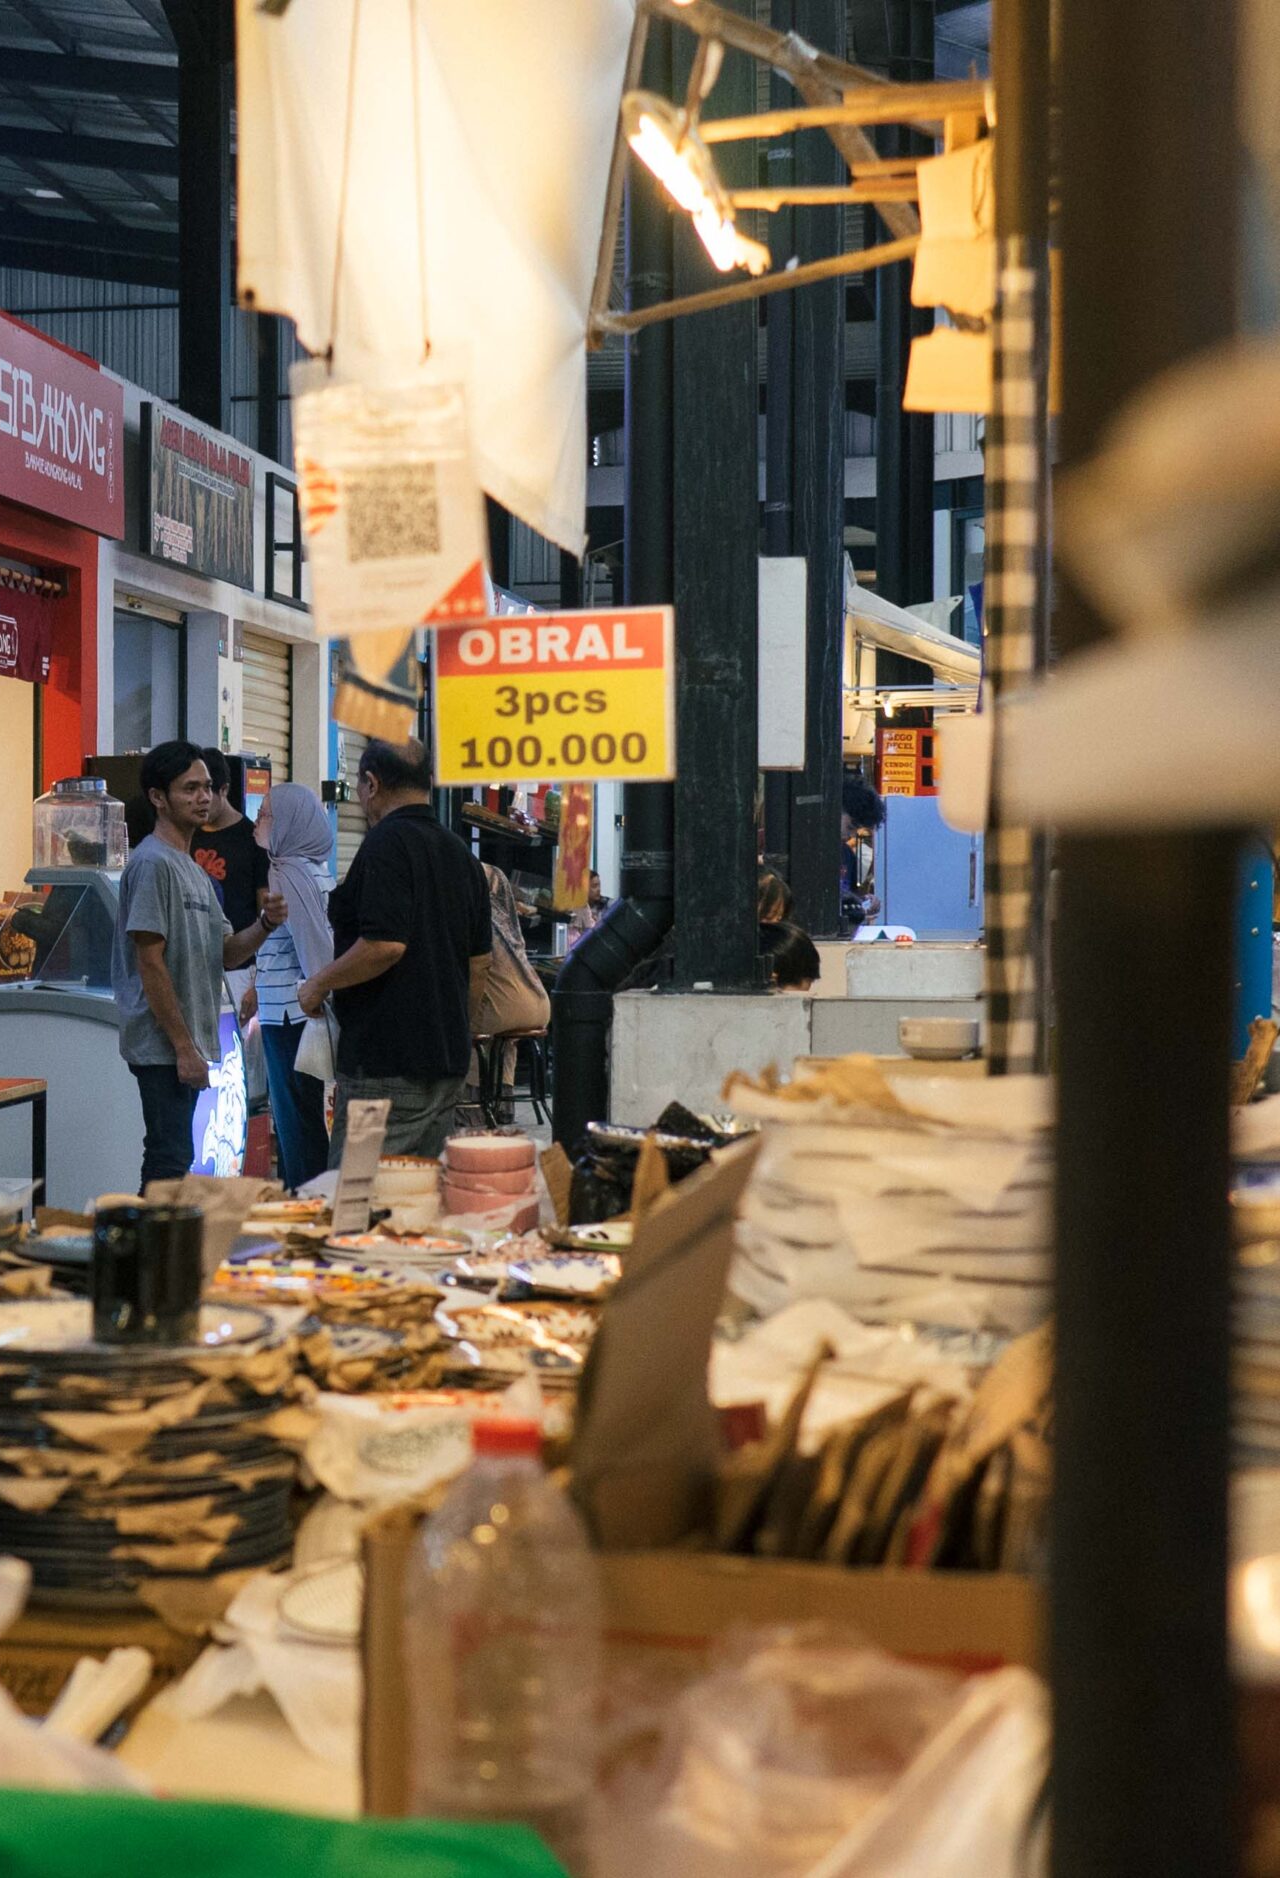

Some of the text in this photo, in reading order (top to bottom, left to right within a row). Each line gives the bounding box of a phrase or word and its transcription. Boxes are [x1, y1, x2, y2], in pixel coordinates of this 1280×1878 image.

[458, 623, 644, 666] OBRAL
[495, 685, 608, 724] 3pcs
[460, 732, 647, 768] 100.000
